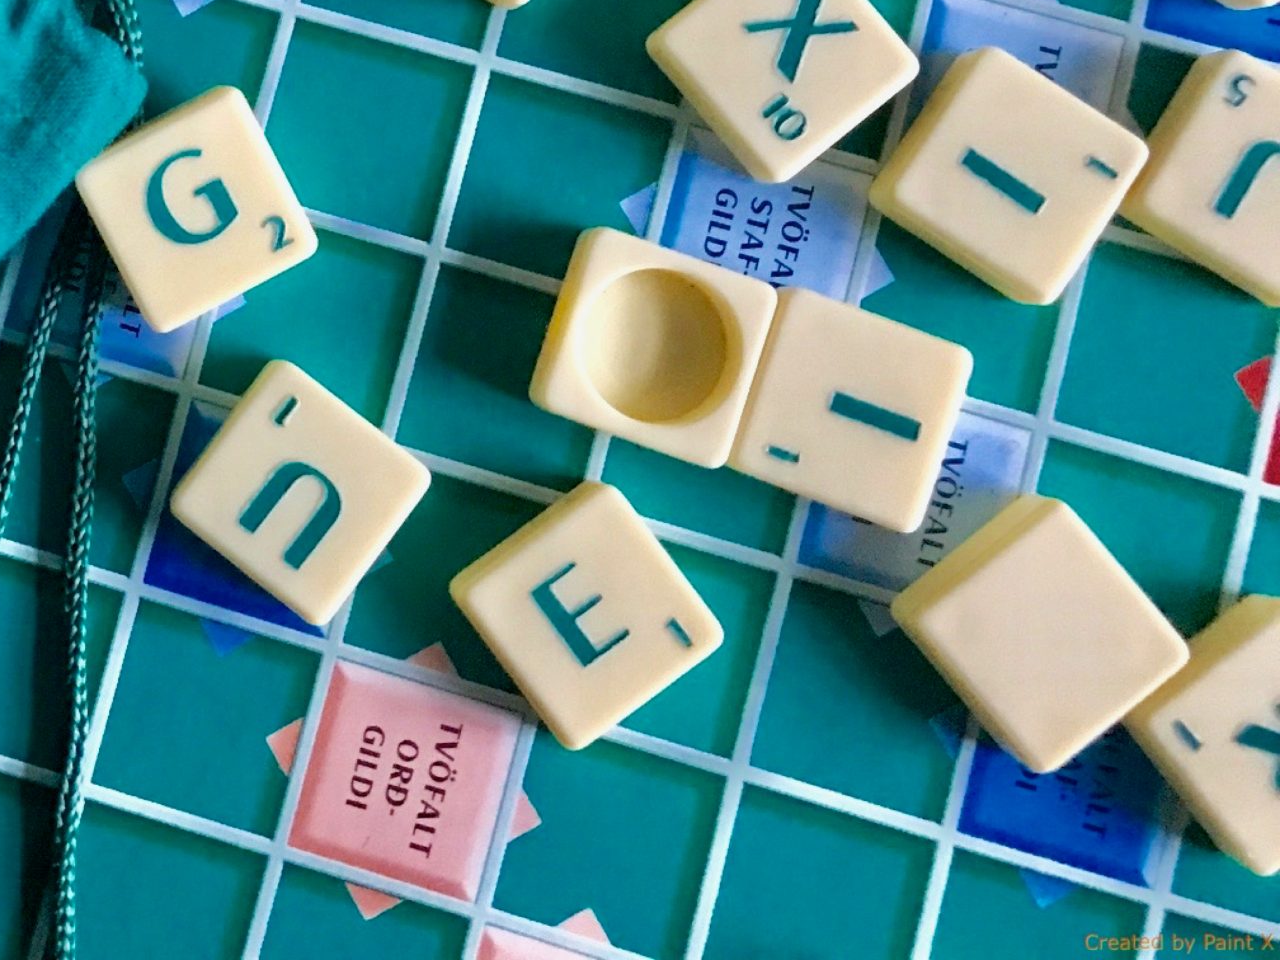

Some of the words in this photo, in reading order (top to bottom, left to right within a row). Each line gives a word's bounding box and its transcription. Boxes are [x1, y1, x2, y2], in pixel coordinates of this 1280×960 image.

[145, 148, 239, 246] G
[704, 188, 738, 265] GILD
[237, 460, 343, 572] U
[530, 561, 631, 668] E
[345, 725, 385, 810] GILDI
[409, 724, 464, 859] TVÖFALT
